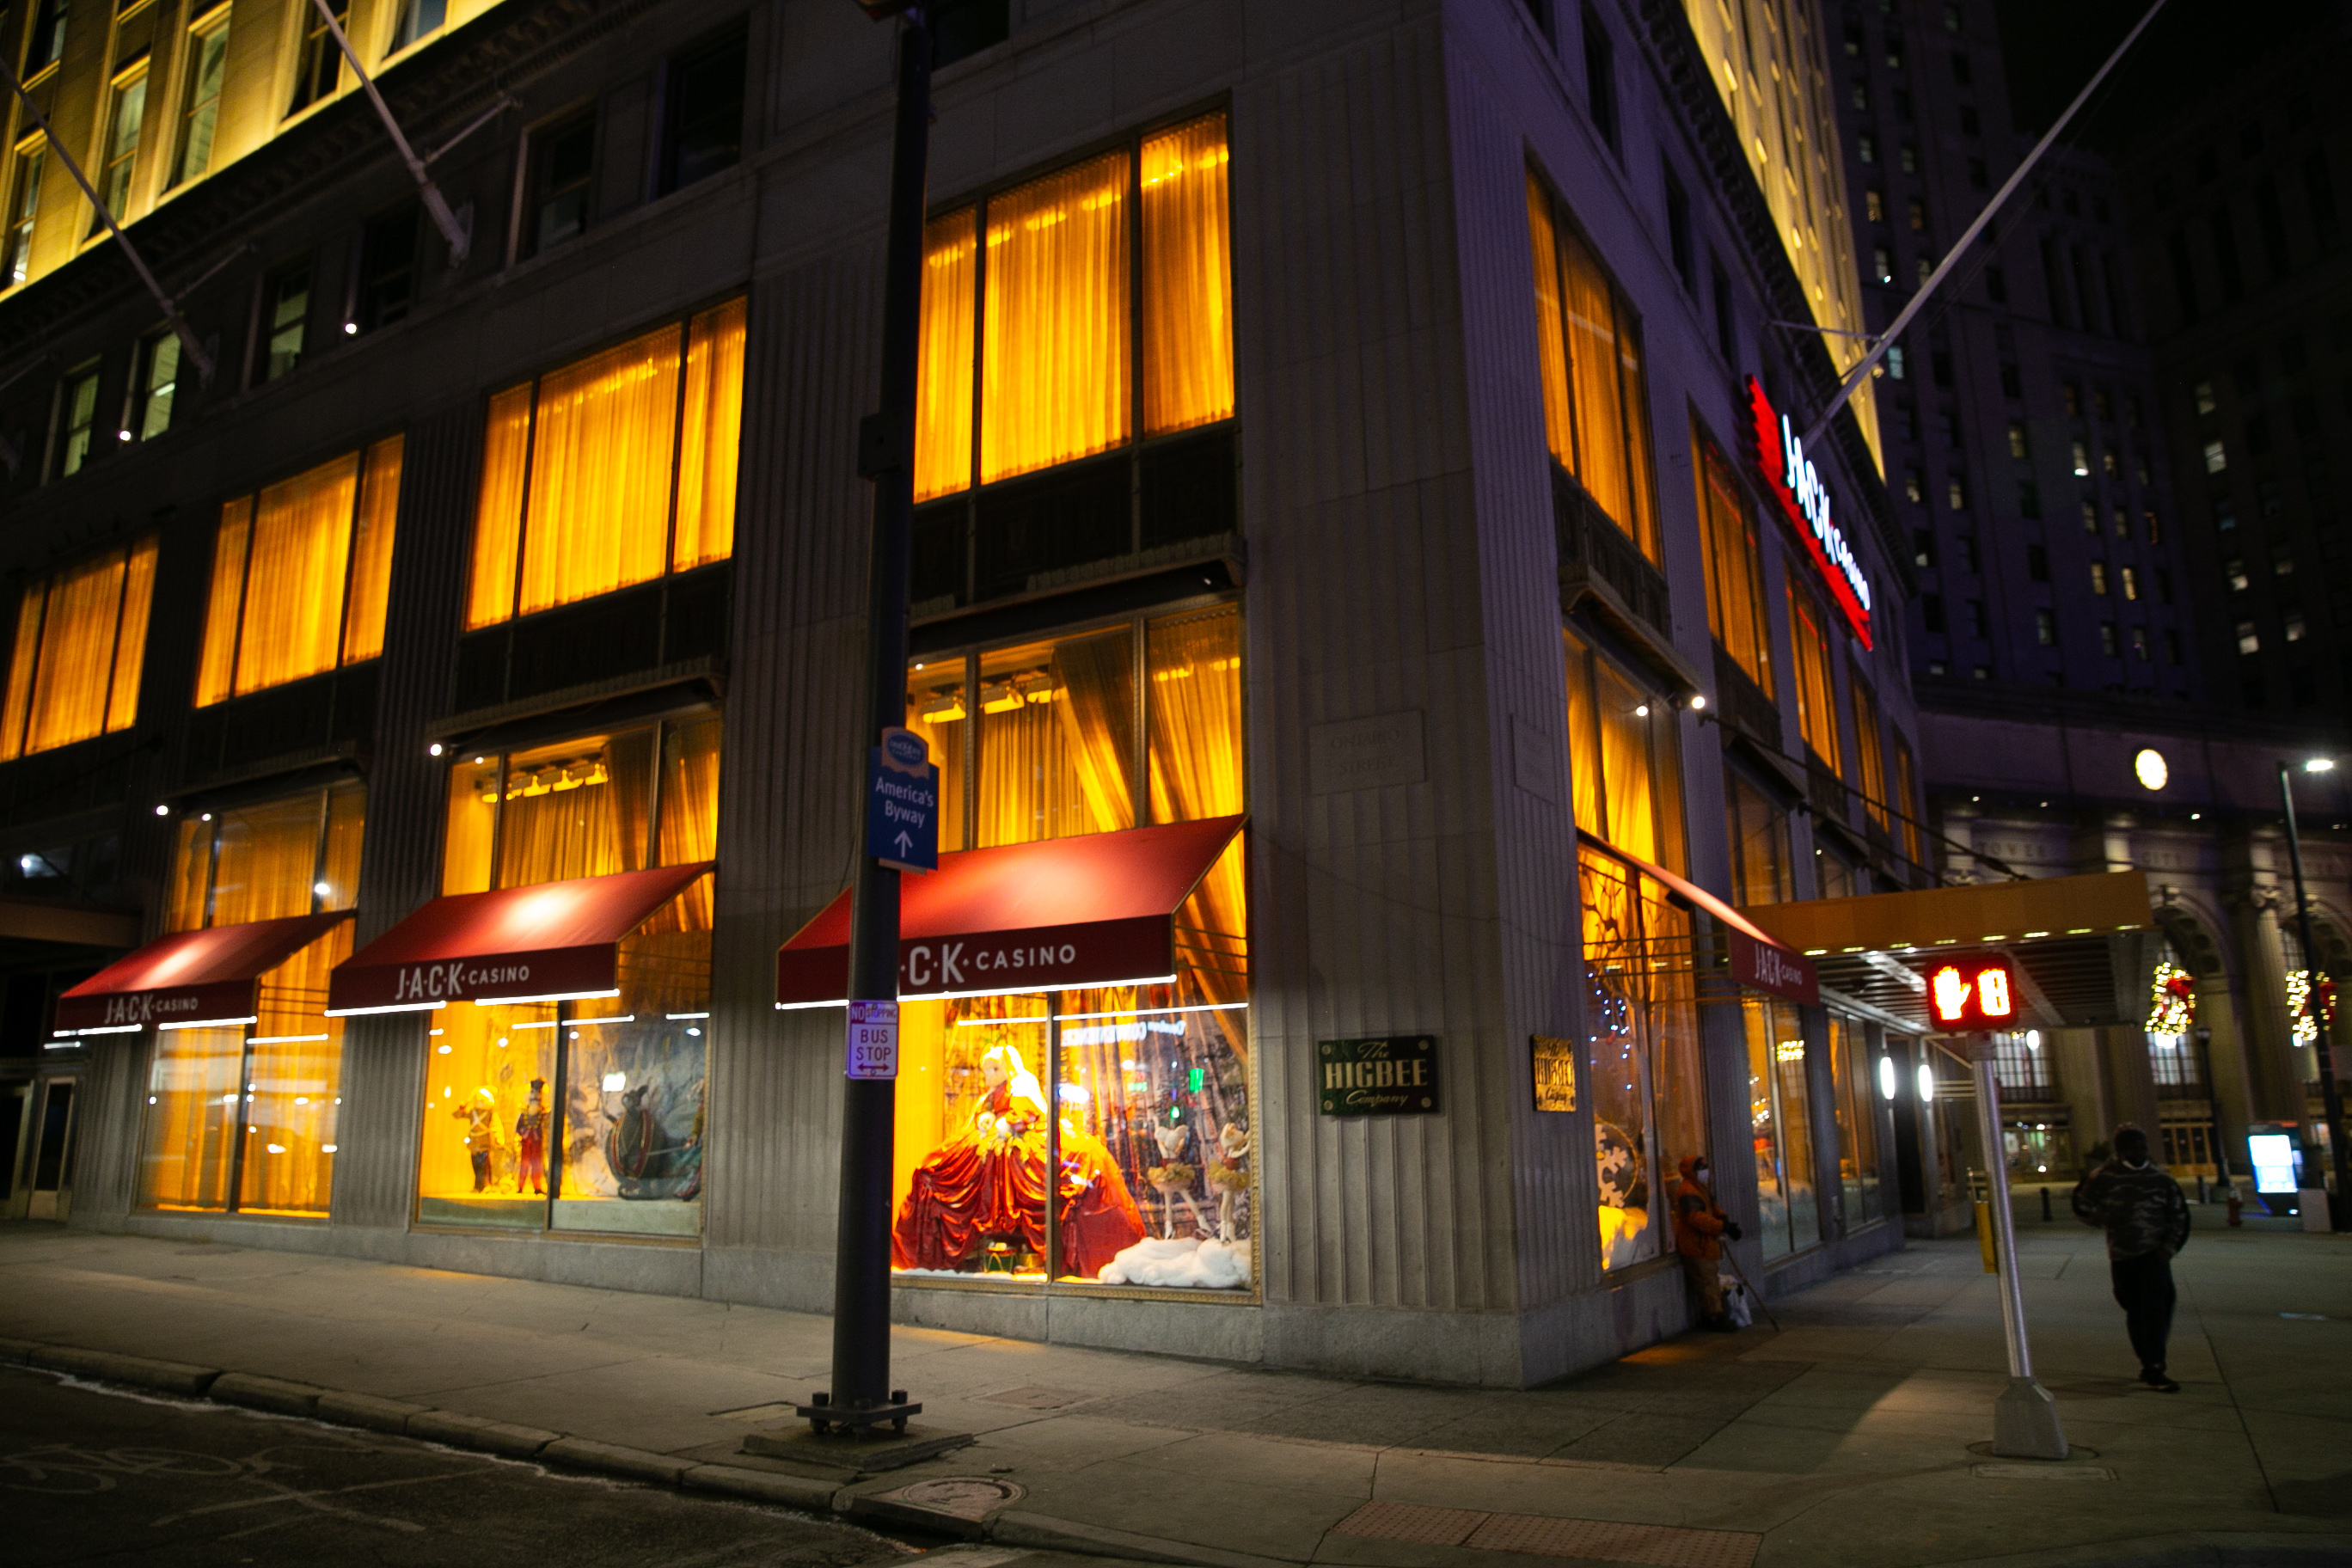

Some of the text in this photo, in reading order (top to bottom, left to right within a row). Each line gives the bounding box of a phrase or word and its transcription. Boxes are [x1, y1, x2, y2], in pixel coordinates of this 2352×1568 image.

[875, 776, 934, 807] America's
[885, 799, 925, 829] Byway
[976, 944, 1075, 971] CASINO
[468, 965, 530, 985] CASINO
[155, 997, 199, 1013] CASINO
[850, 1005, 866, 1022] NO
[860, 1029, 889, 1044] BUS
[855, 1046, 892, 1062] STOP
[1357, 1040, 1390, 1059] The
[1325, 1058, 1427, 1090] HIGBEE
[1345, 1089, 1409, 1107] Company
